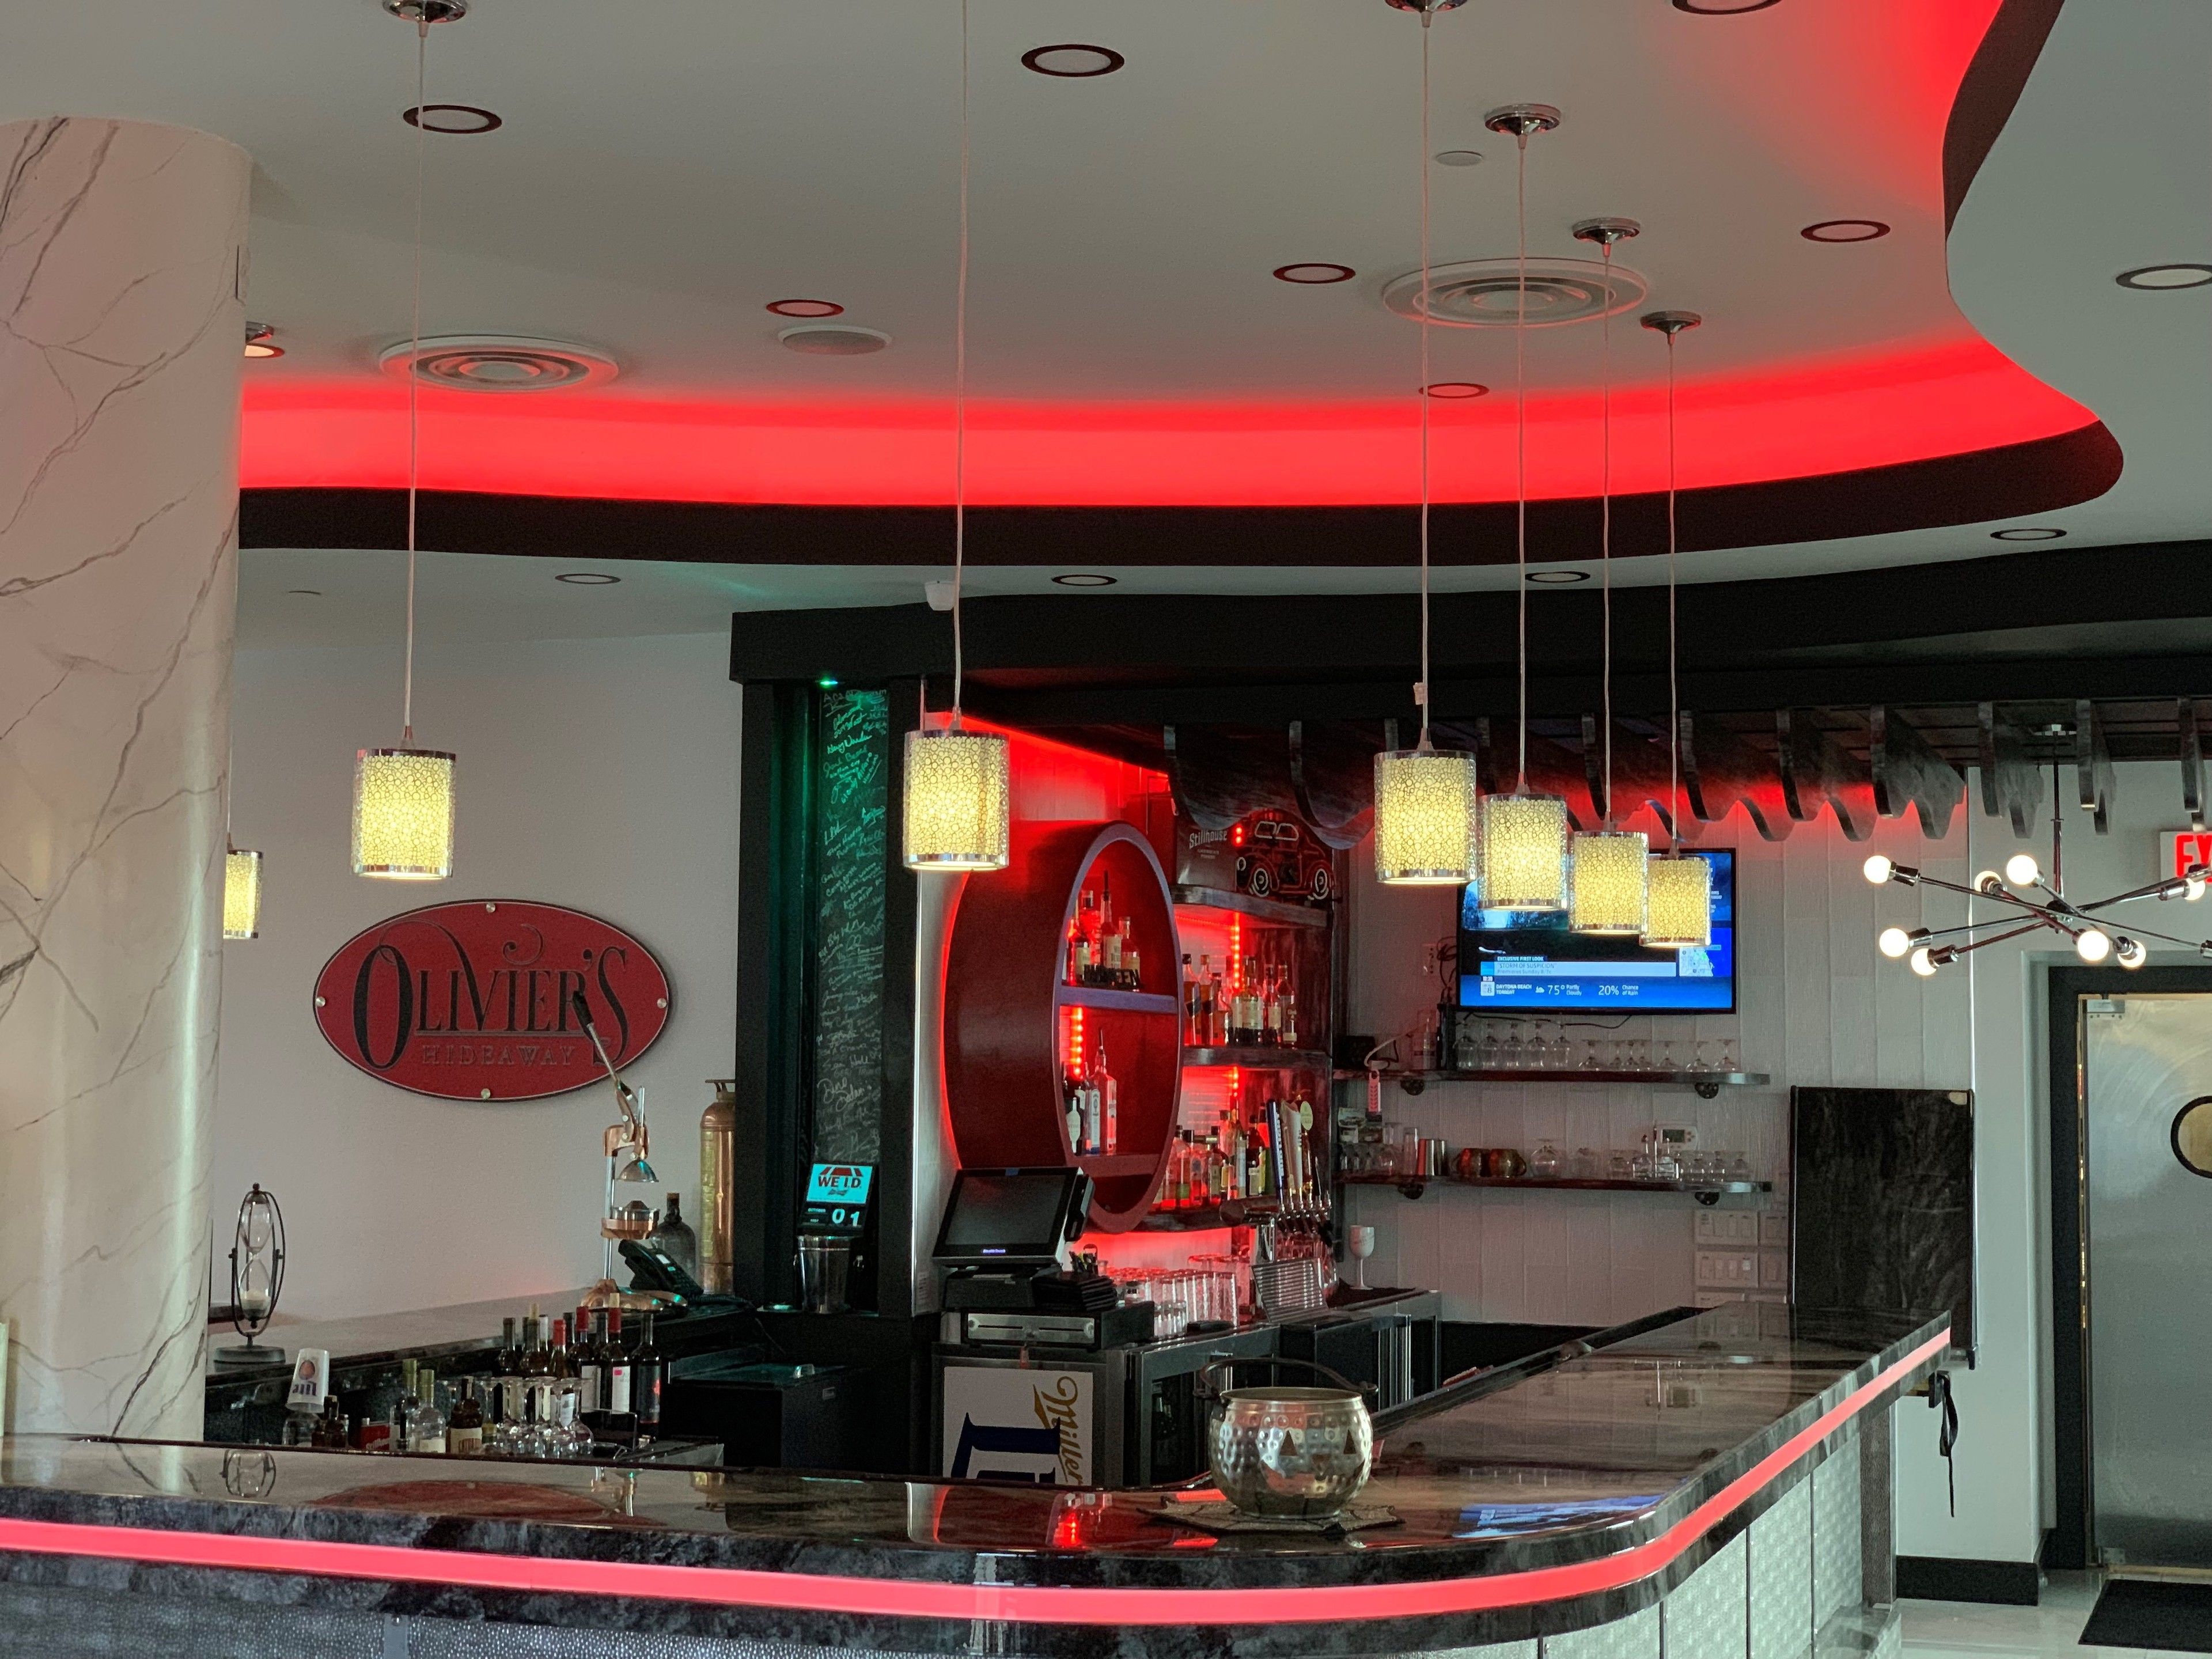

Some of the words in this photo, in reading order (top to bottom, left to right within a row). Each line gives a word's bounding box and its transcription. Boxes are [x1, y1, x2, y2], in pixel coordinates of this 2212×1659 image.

[1598, 984, 1619, 995] 20%
[422, 1044, 575, 1066] HIDEAWAY
[818, 1176, 840, 1188] WE
[1040, 1376, 1084, 1486] Miller
